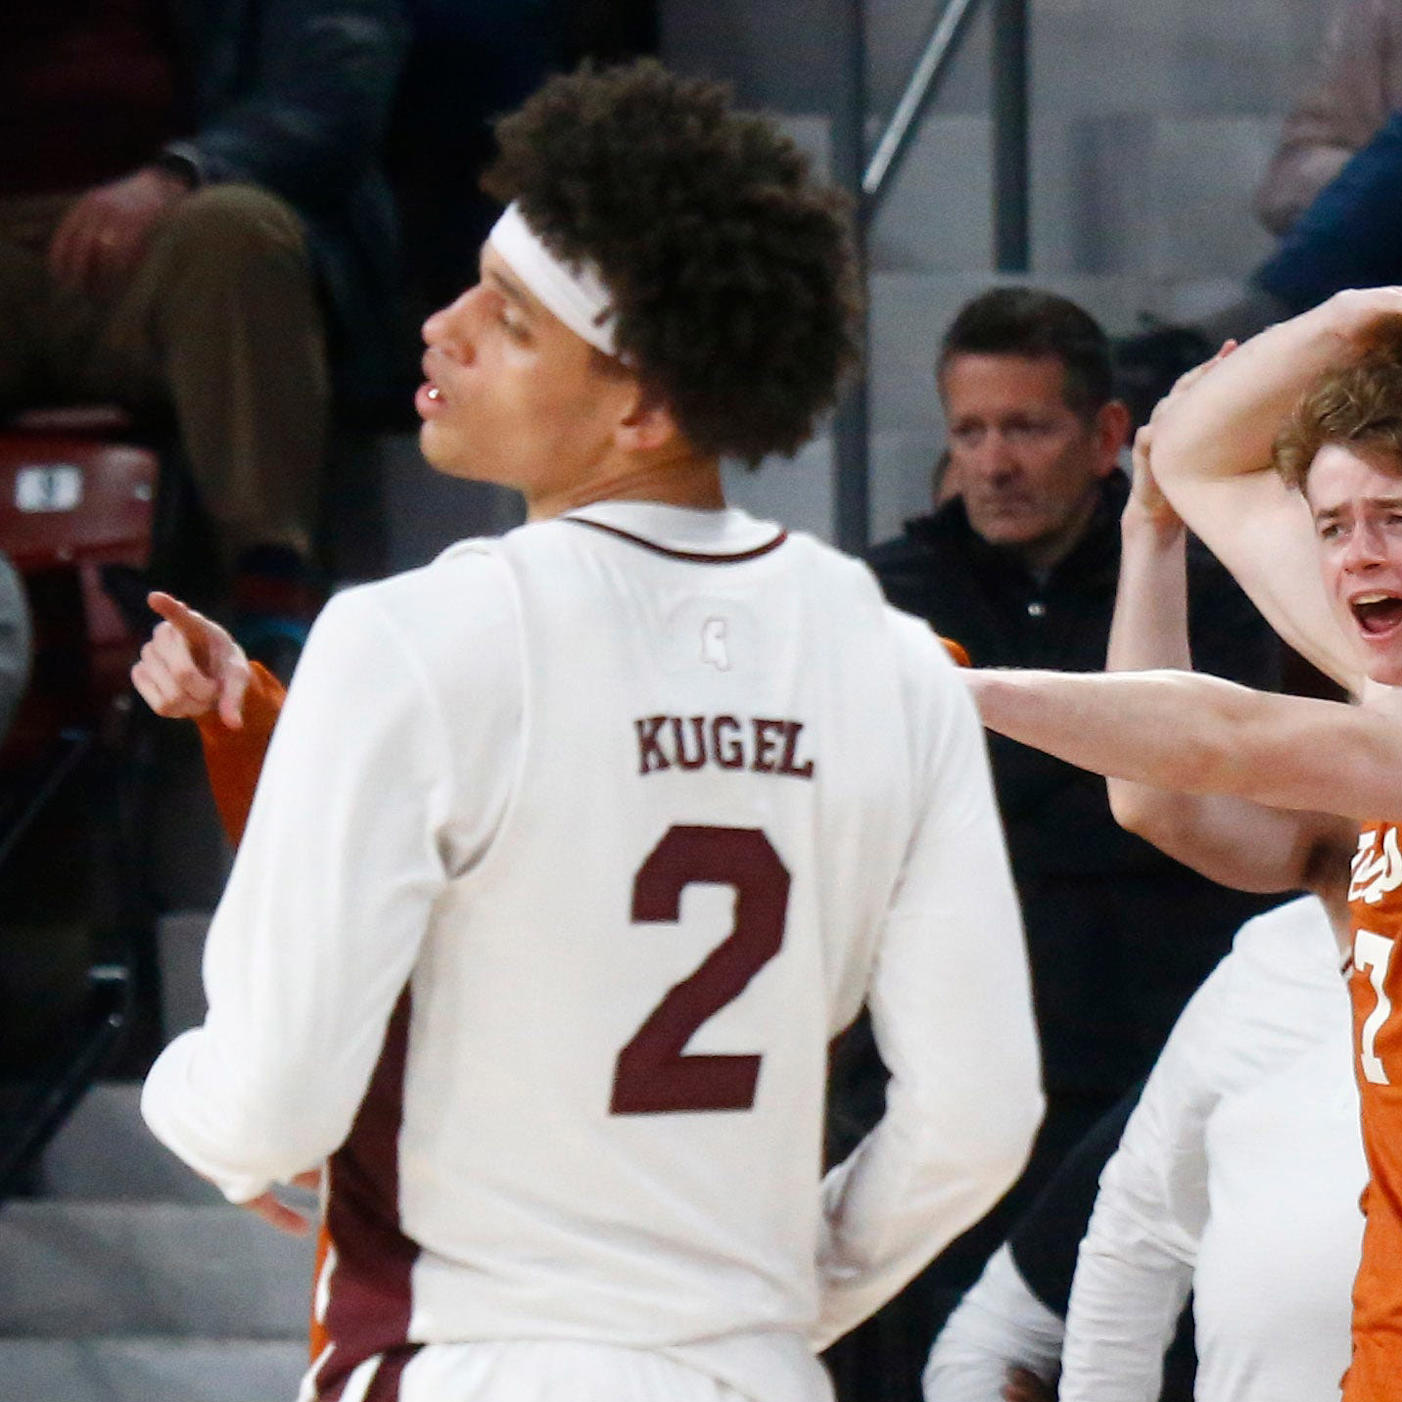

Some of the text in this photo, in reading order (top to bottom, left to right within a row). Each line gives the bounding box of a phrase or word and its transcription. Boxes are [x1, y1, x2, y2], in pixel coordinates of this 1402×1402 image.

[634, 715, 815, 780] KUGEL
[608, 824, 792, 1116] 2
[1353, 928, 1395, 1086] 7
